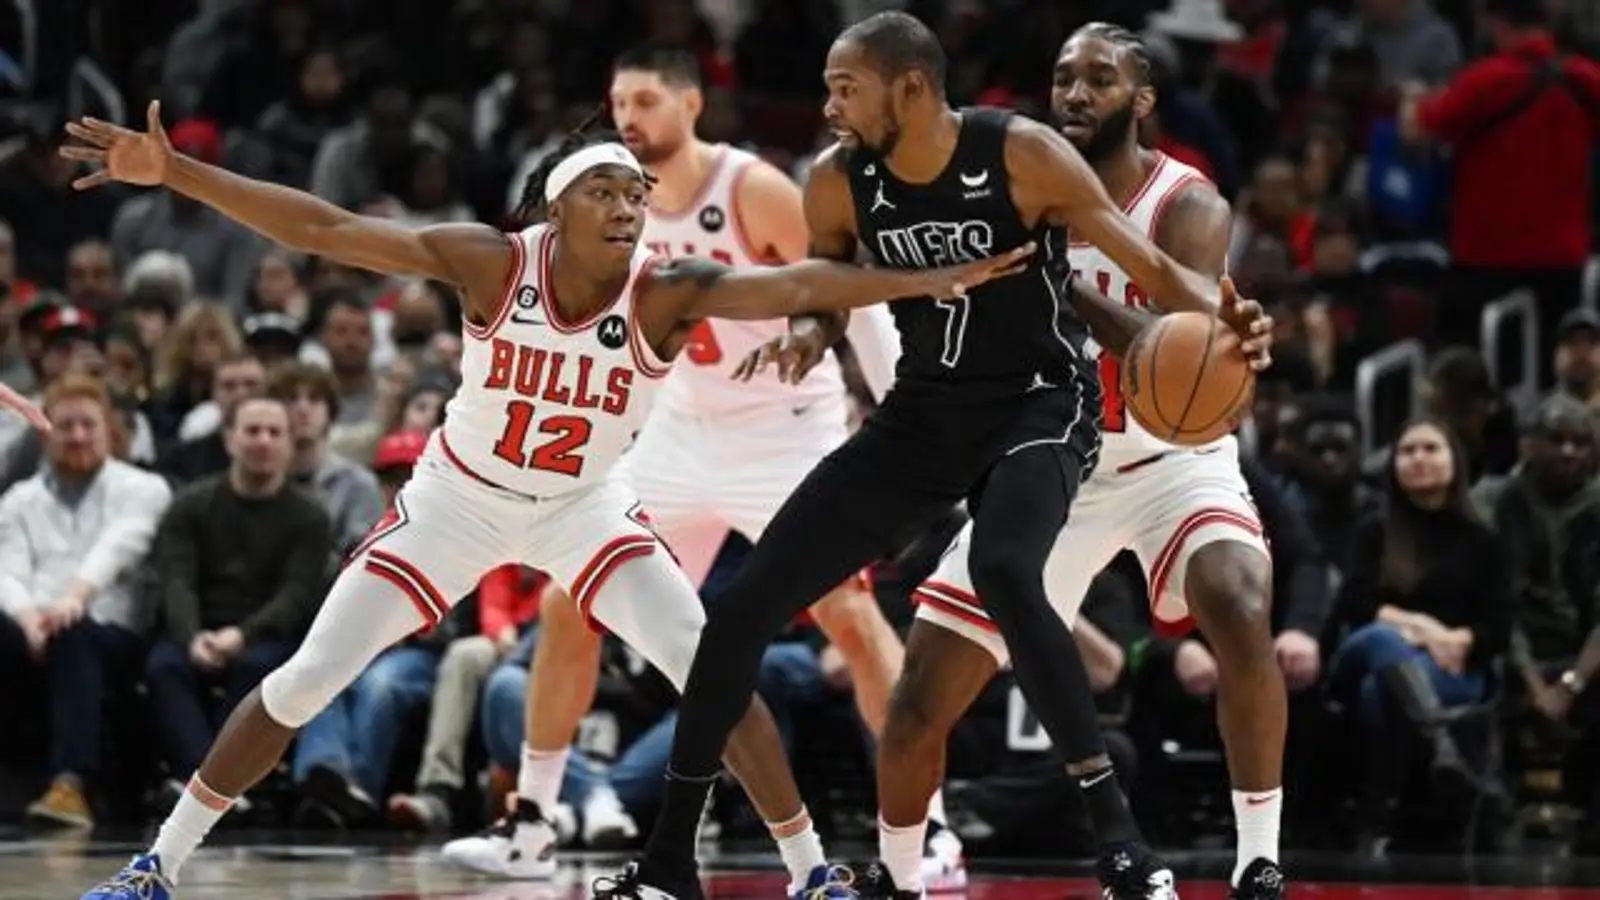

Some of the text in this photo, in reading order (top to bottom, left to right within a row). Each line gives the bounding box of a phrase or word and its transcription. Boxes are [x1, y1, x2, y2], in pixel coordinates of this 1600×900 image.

[877, 220, 993, 268] NETS
[519, 288, 536, 307] 6
[935, 294, 970, 368] 7
[484, 337, 634, 416] BULLS
[492, 399, 594, 478] 12
